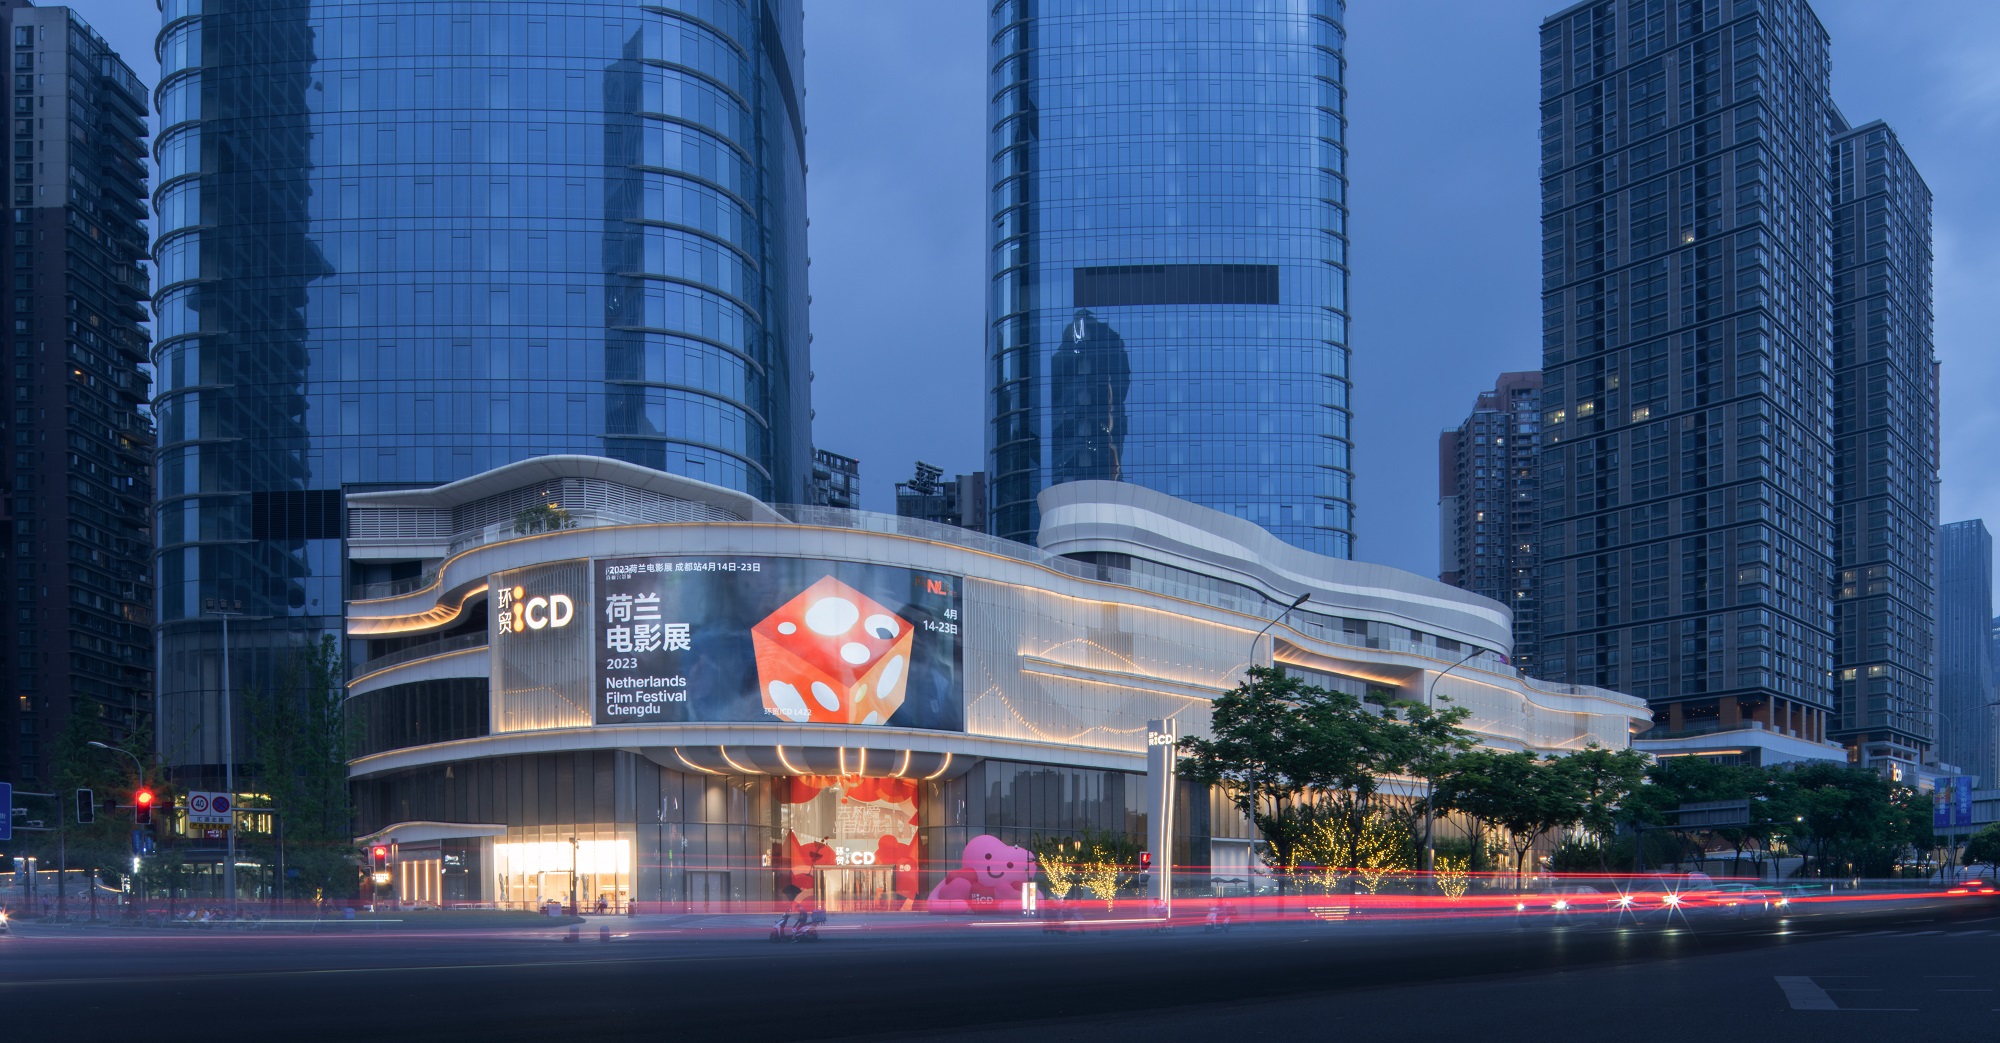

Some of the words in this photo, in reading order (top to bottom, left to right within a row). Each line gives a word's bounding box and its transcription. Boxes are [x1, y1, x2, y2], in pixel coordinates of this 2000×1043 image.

[609, 562, 673, 574] 2023荷兰电影展
[498, 587, 513, 635] 环贸
[605, 592, 662, 623] 荷兰
[943, 608, 958, 620] 4月
[923, 620, 958, 635] 14-23日
[606, 623, 691, 653] 电影展
[606, 657, 638, 670] 2023
[606, 675, 687, 690] Netherlands
[606, 691, 633, 704] Film
[635, 690, 687, 703] Festival
[607, 702, 661, 717] Chengdu
[794, 708, 812, 716] L422
[195, 799, 205, 808] 40
